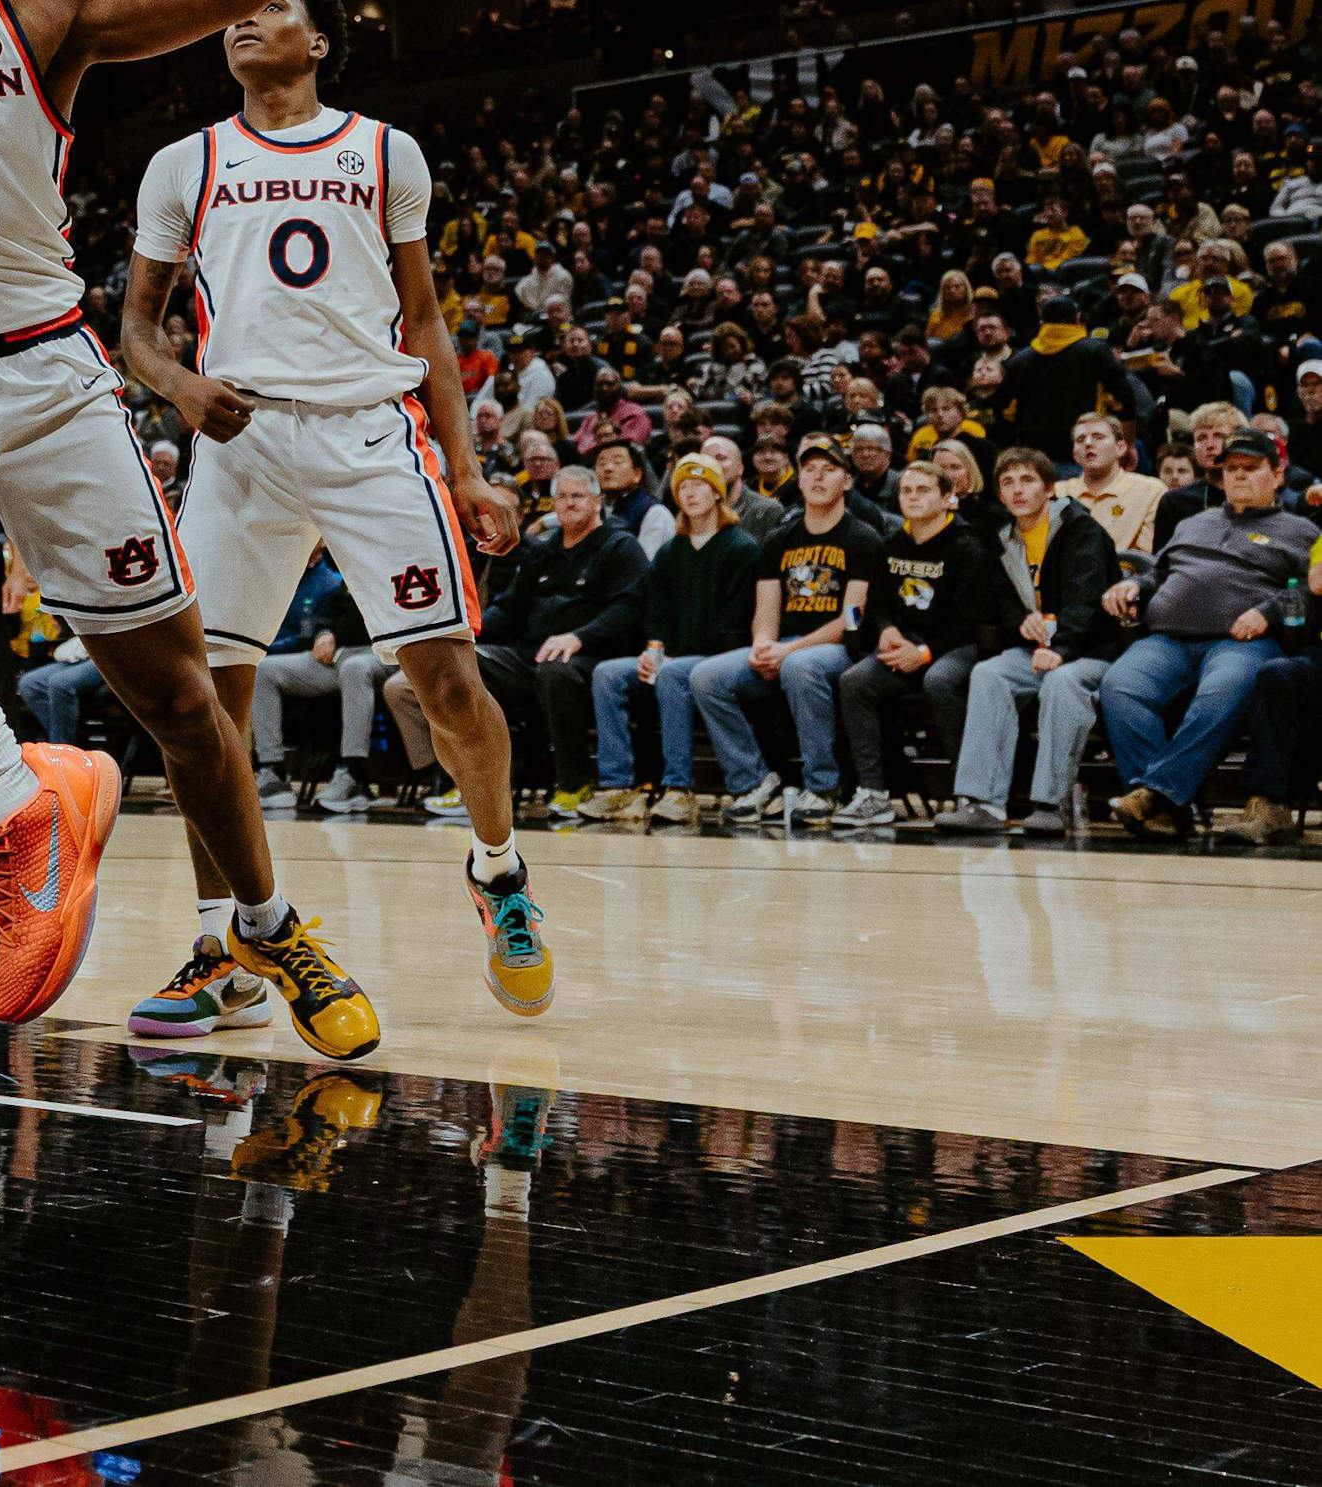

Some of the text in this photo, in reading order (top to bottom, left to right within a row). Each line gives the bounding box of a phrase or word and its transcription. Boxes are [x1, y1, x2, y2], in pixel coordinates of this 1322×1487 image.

[210, 179, 376, 211] AUBURN
[268, 218, 331, 290] 0
[781, 545, 846, 572] FIGHT FOR
